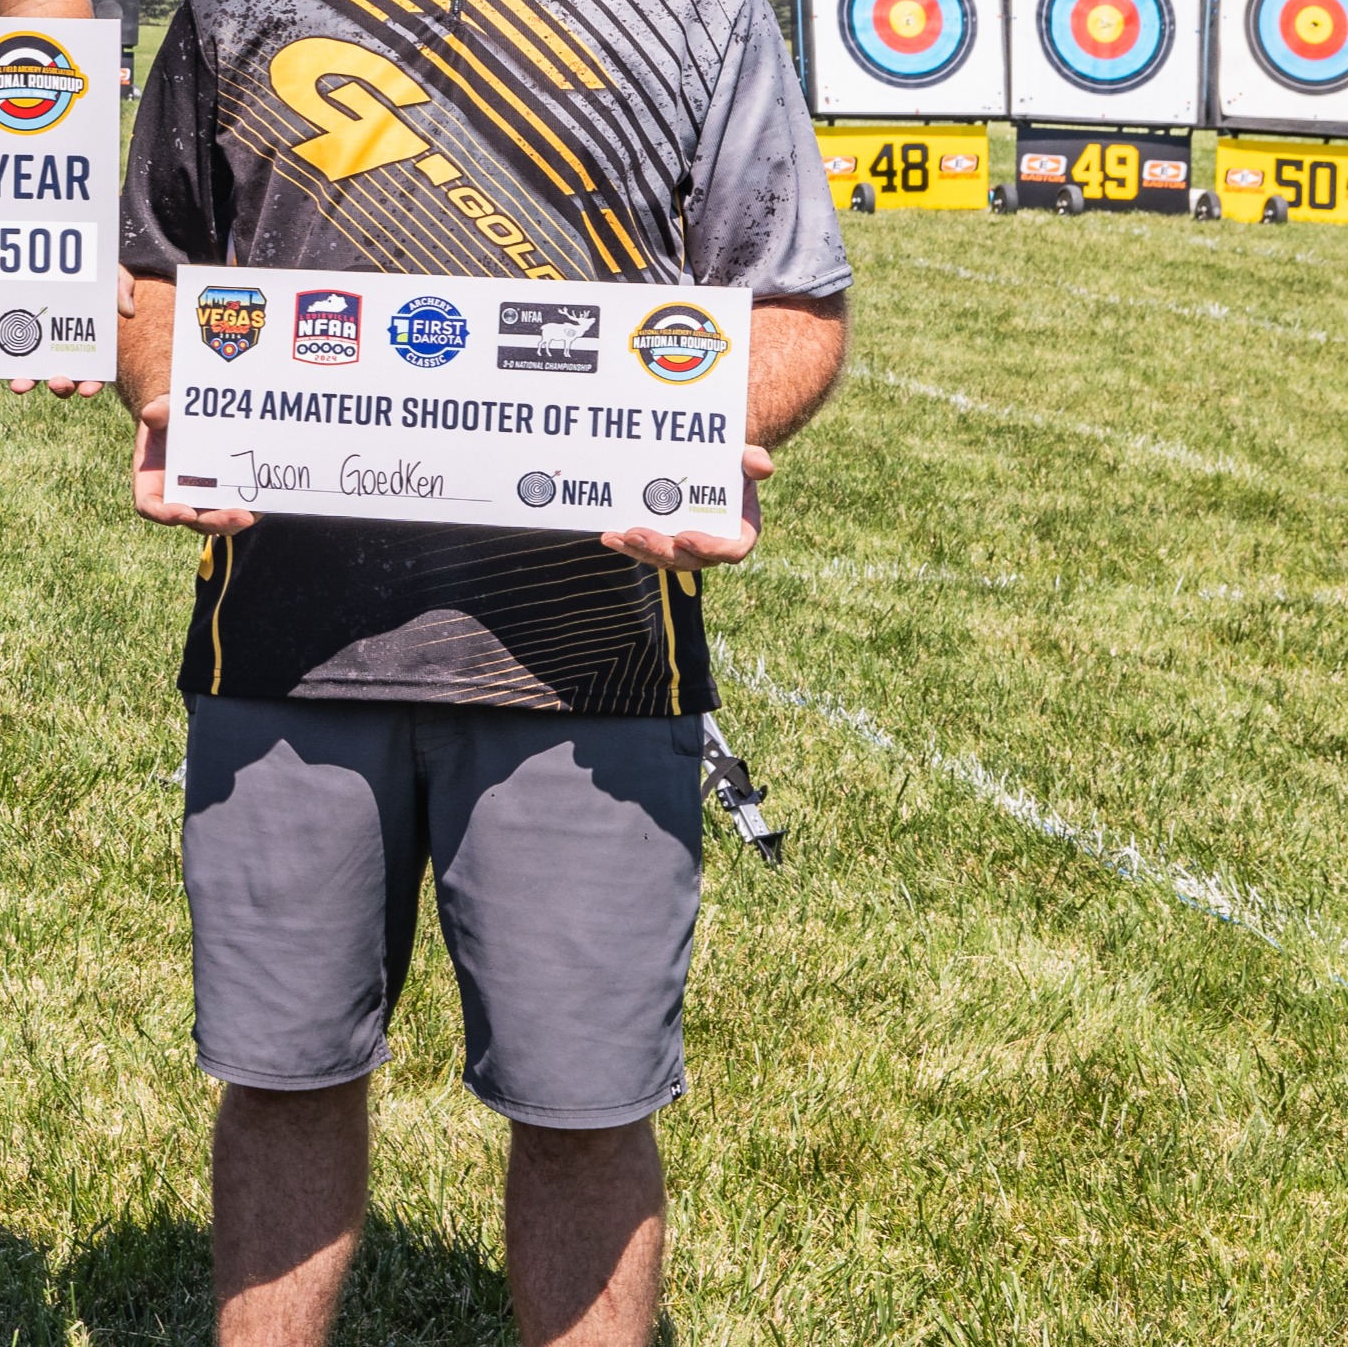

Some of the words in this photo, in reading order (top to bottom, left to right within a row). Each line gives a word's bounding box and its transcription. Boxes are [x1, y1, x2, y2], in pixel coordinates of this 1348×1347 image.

[28, 75, 83, 92] ROUNDUP
[869, 143, 929, 193] 48
[1071, 143, 1139, 200] 49
[1275, 158, 1337, 210] 50
[52, 317, 96, 342] NFAA
[196, 308, 265, 327] VEGAS
[298, 319, 356, 338] NFAA
[413, 320, 463, 334] FIRST
[412, 333, 463, 345] DAKOTA
[185, 387, 252, 419] 2024
[260, 391, 392, 426] AMATEUR
[402, 398, 533, 433] SHOOTER
[544, 405, 579, 436] OF
[588, 407, 642, 439] THE
[652, 410, 726, 443] YEAR
[230, 450, 310, 502] Jason
[562, 480, 612, 508] NFAA
[690, 486, 727, 506] NFAA
